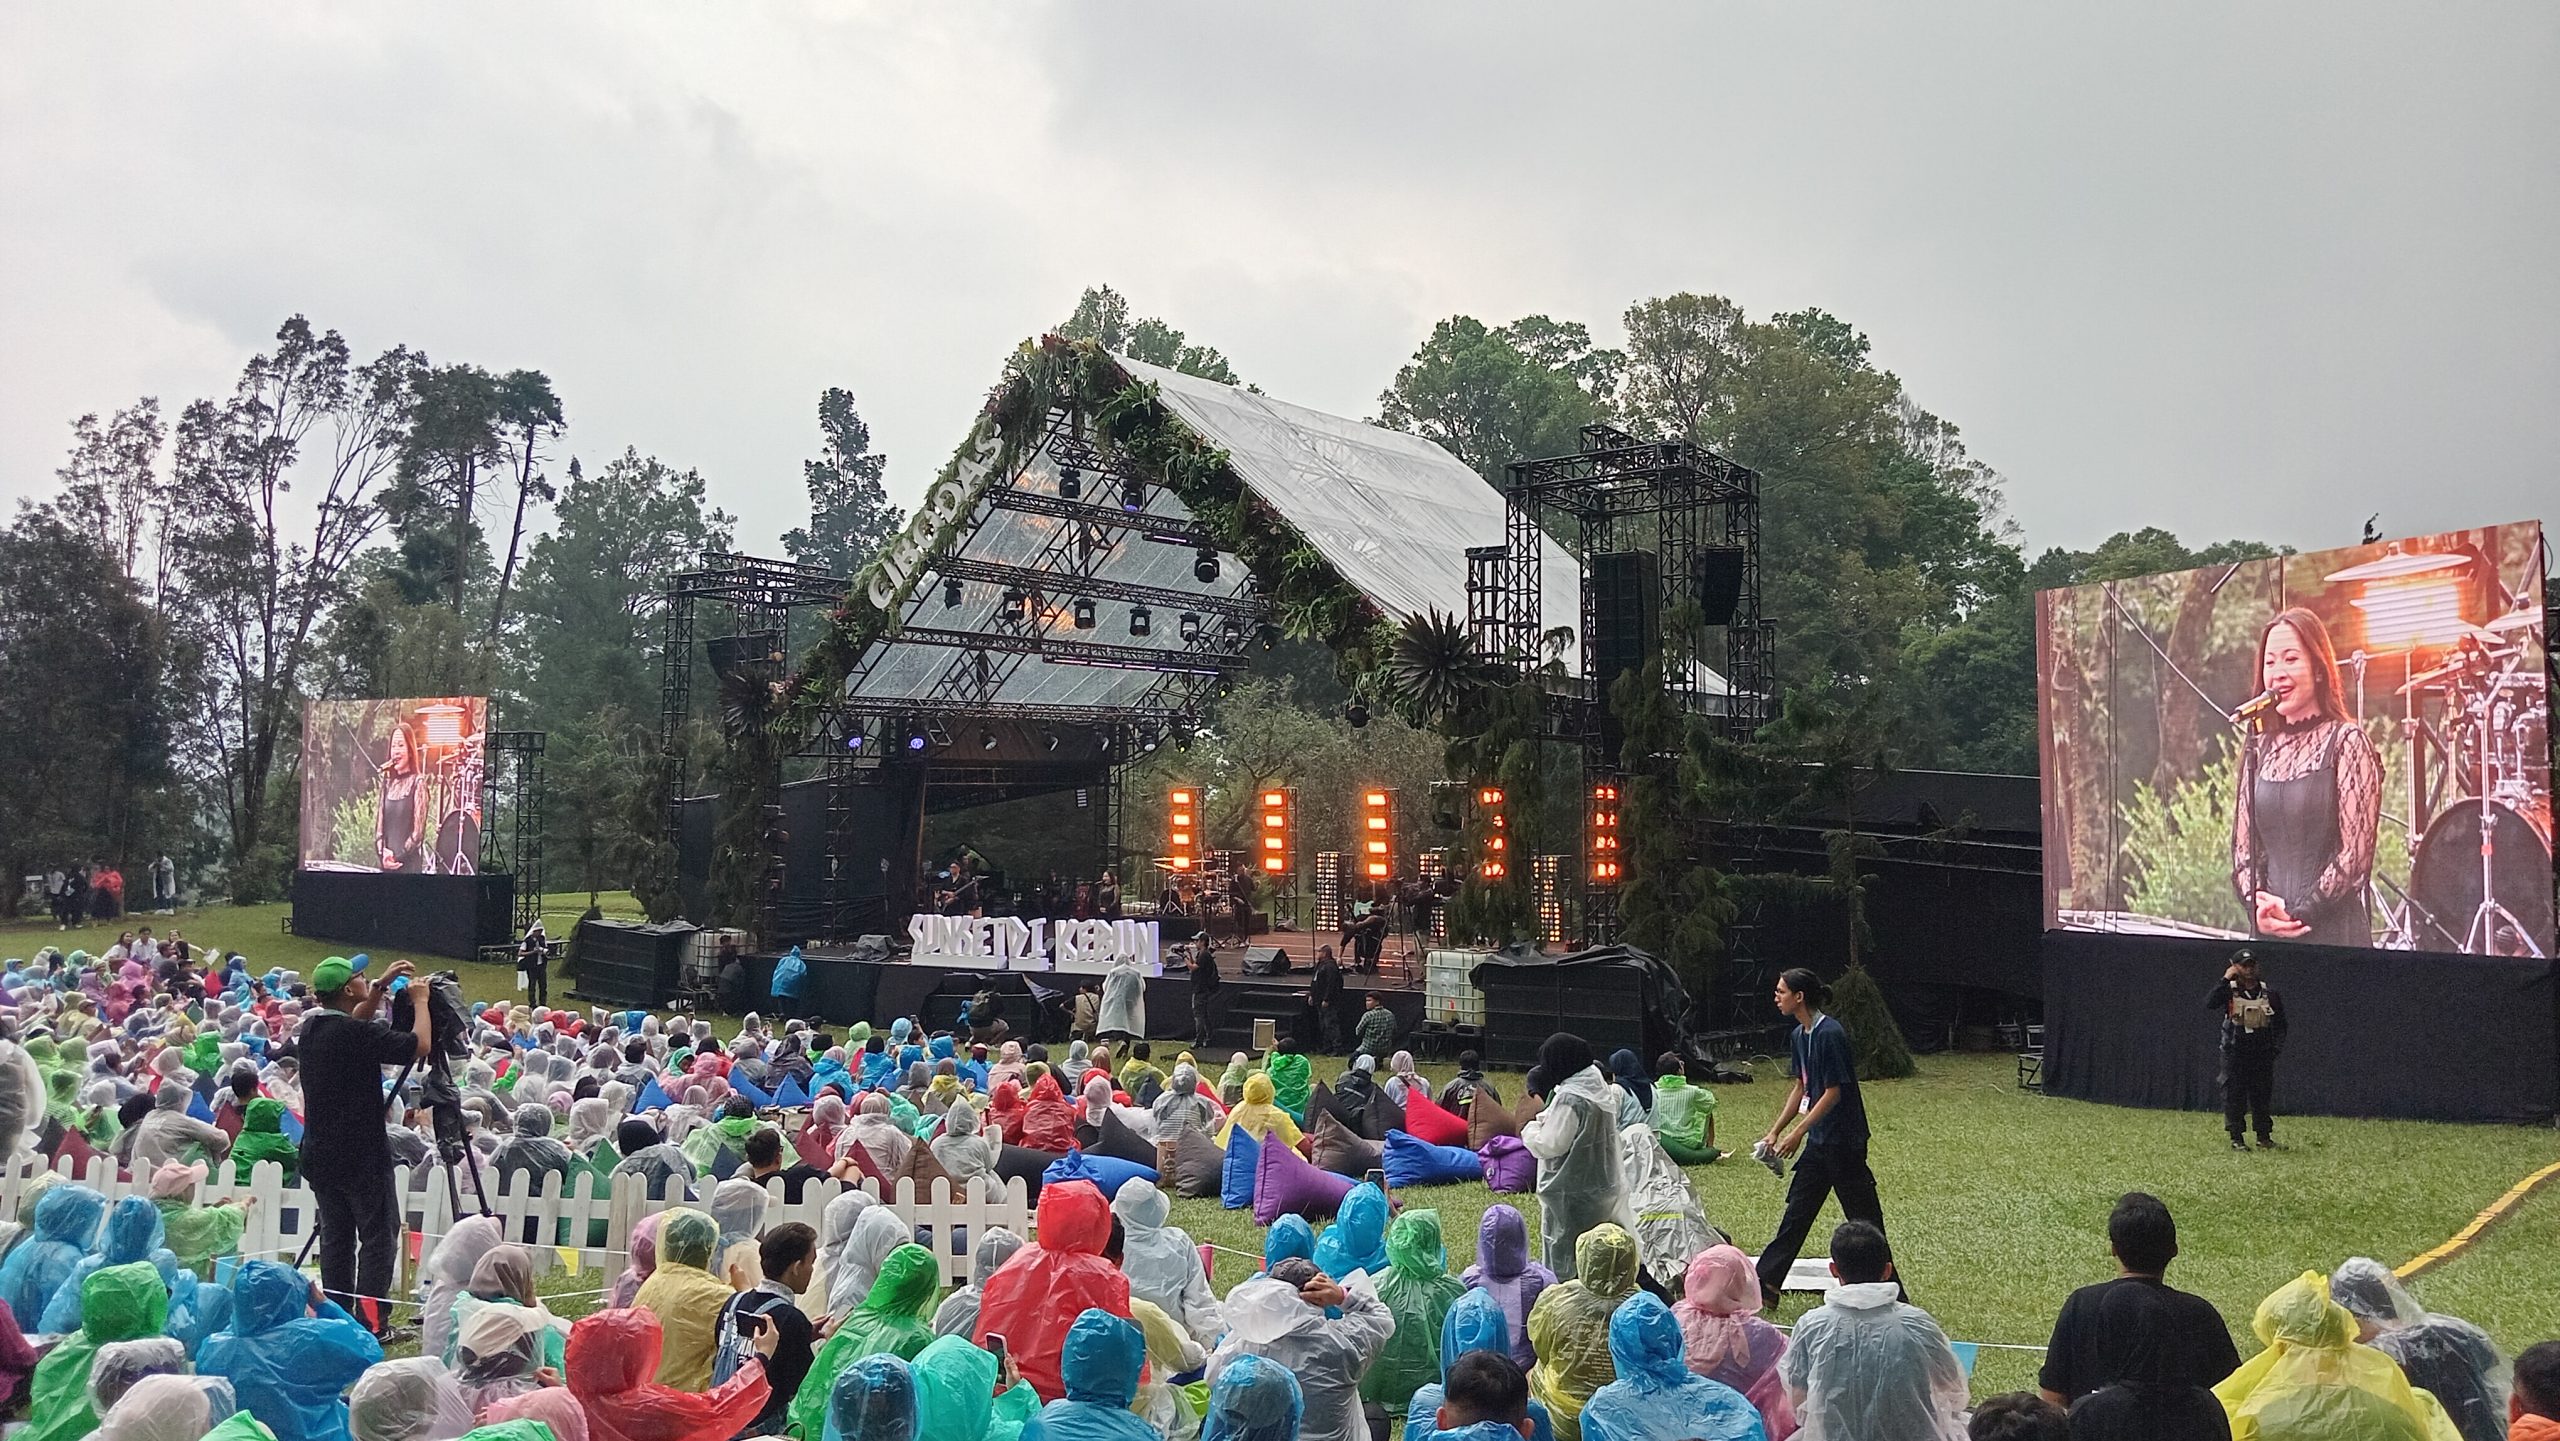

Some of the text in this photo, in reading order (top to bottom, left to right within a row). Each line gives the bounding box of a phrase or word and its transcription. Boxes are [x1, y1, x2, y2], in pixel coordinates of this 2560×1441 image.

[867, 428, 1004, 610] CIBODAS
[907, 914, 1160, 963] SUNSET DI KEBUN
